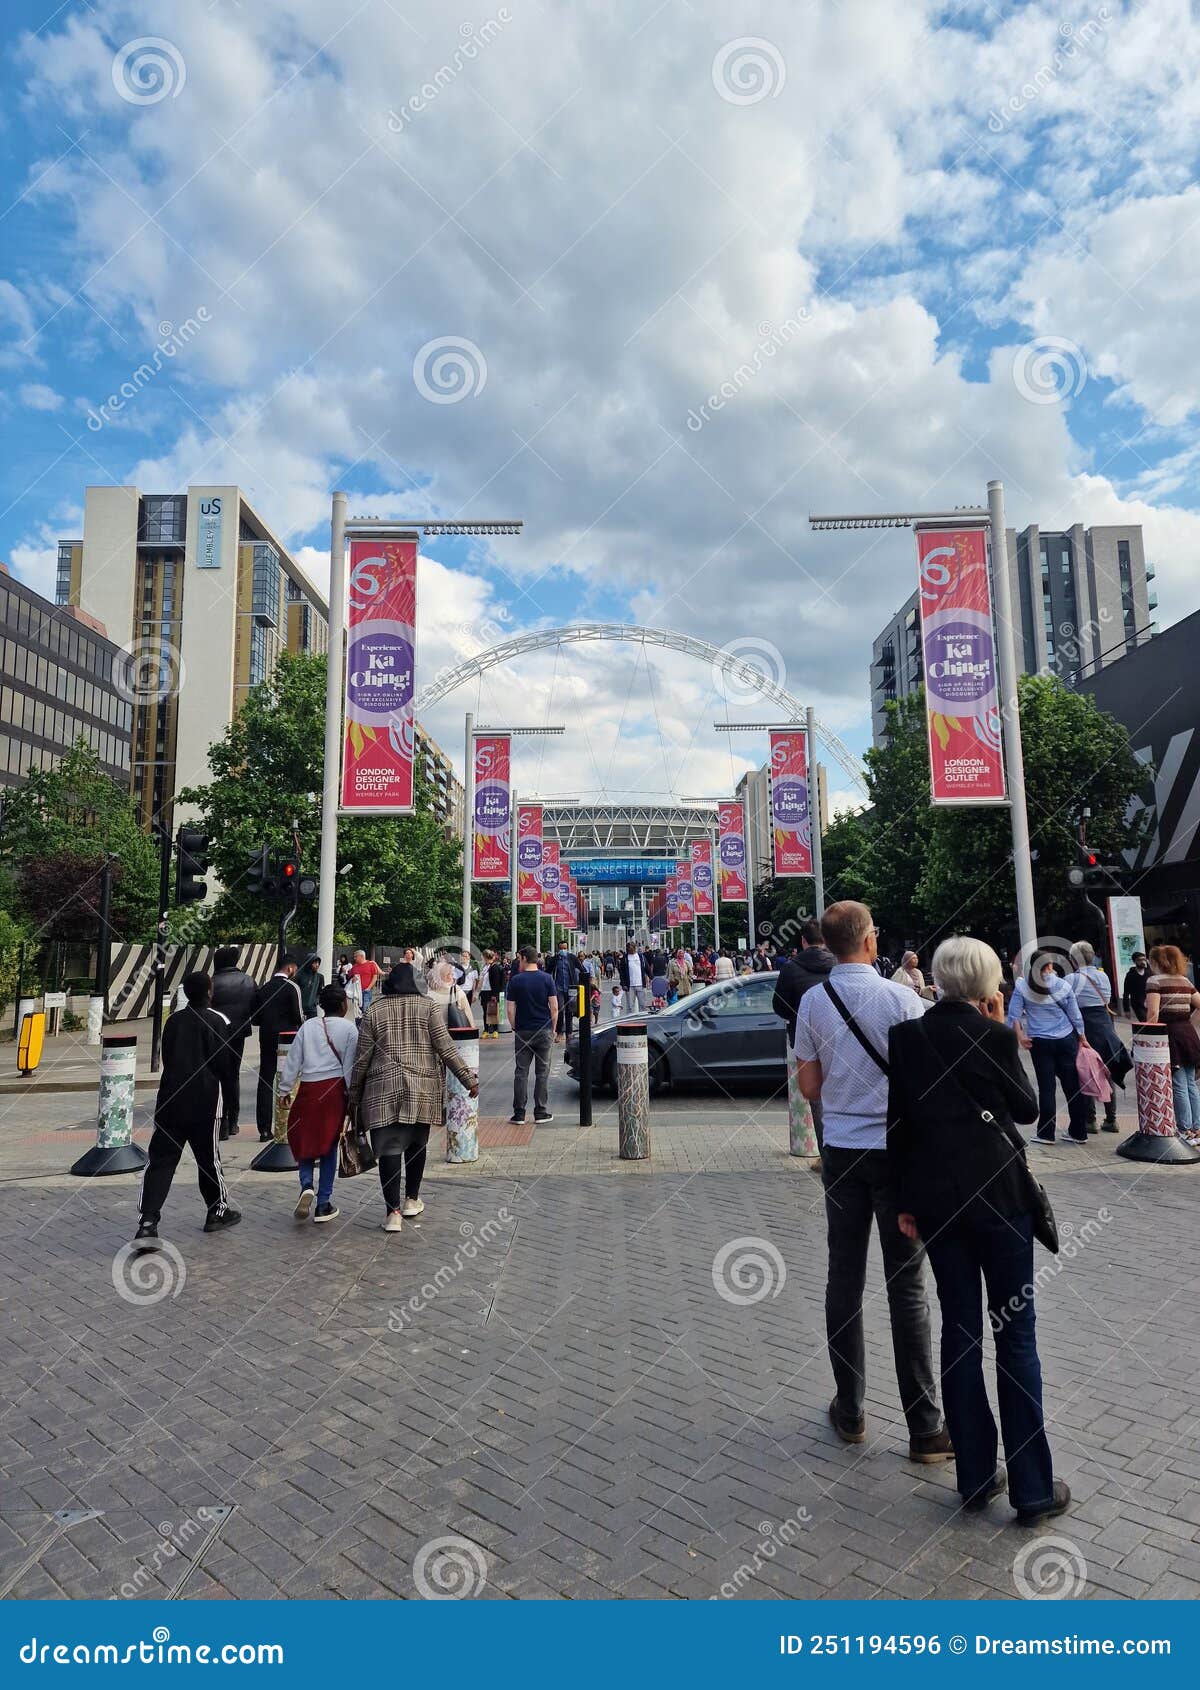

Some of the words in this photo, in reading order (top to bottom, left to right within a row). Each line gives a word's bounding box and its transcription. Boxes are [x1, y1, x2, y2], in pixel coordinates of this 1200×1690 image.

[206, 530, 214, 566] WEMBLEY
[946, 643, 972, 659] Ka
[369, 654, 395, 669] Ka
[929, 659, 990, 680] Ching!
[350, 670, 410, 691] Ching!
[580, 865, 643, 875] CONNECTED
